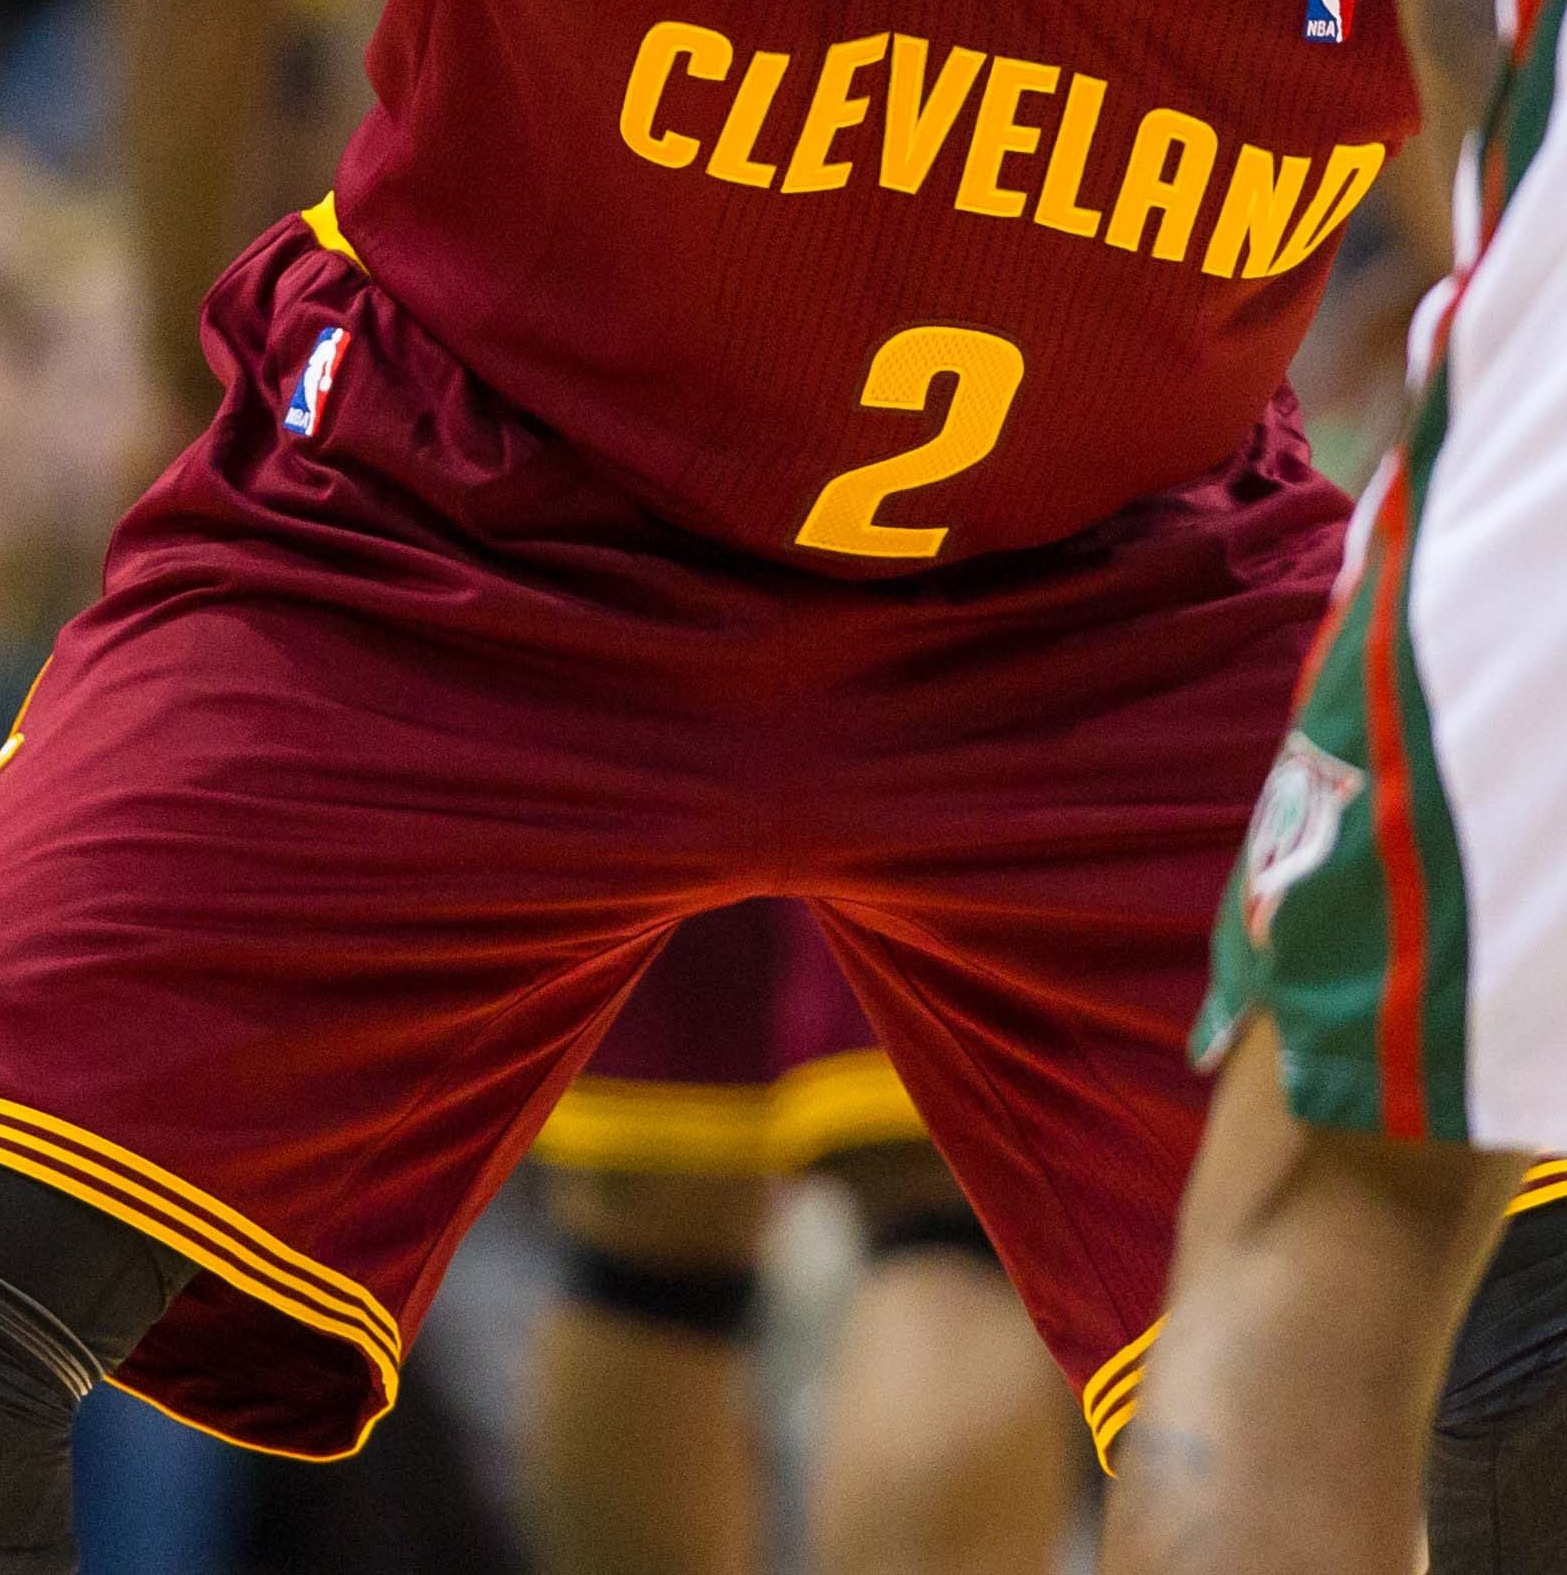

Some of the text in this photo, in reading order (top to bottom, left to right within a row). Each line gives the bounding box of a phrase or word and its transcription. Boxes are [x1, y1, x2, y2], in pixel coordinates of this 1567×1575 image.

[1306, 19, 1336, 38] NBA
[619, 21, 1386, 280] CLEVELAND
[794, 326, 1025, 558] 2
